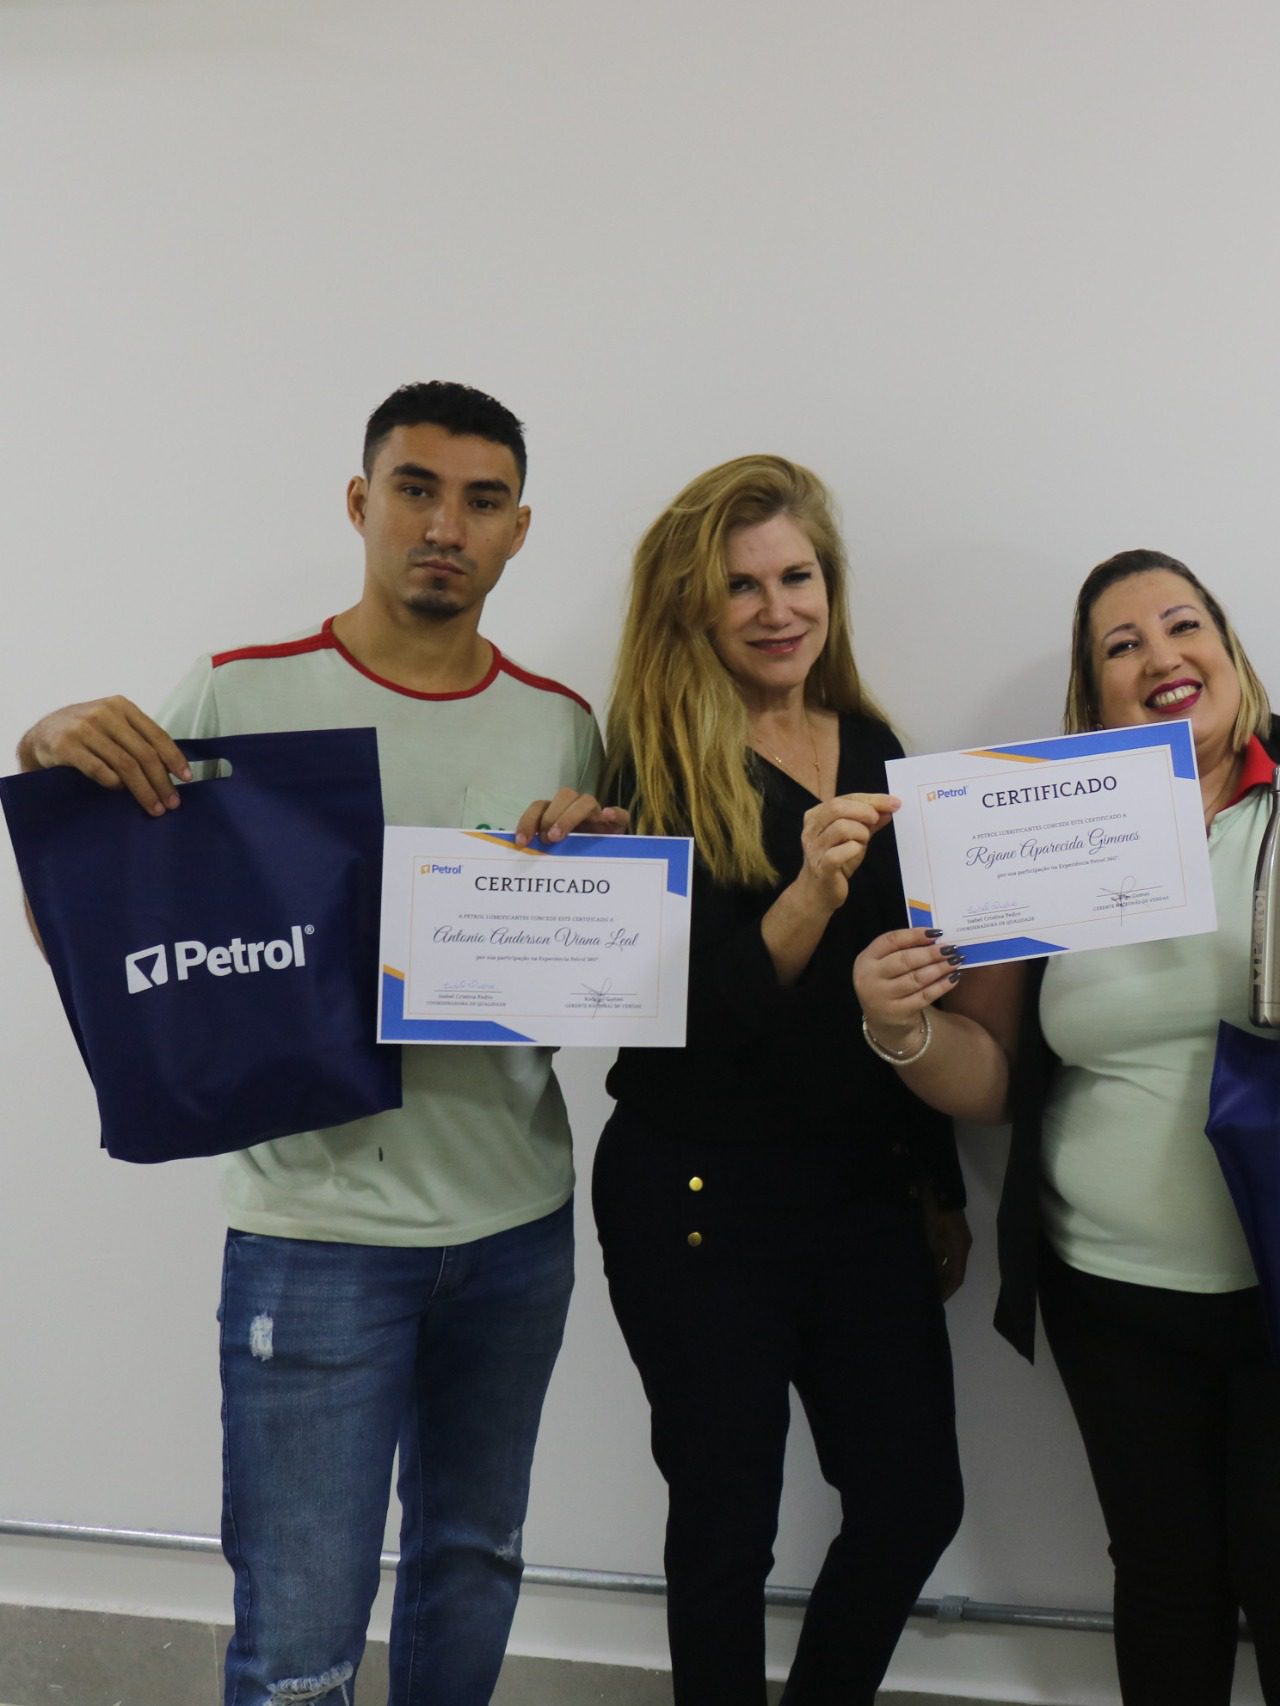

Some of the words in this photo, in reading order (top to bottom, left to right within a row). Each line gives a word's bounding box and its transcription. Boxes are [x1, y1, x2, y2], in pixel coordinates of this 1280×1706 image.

[982, 776, 1117, 808] CERTIFICADO
[966, 846, 1016, 869] Rejane
[1020, 835, 1084, 861] Aparecida
[1088, 828, 1138, 855] Gimenes
[475, 876, 610, 894] CERTIFICADO
[433, 925, 484, 943] Antonio
[490, 927, 550, 944] Anderson
[554, 927, 600, 946] Viana
[604, 928, 639, 951] Leal
